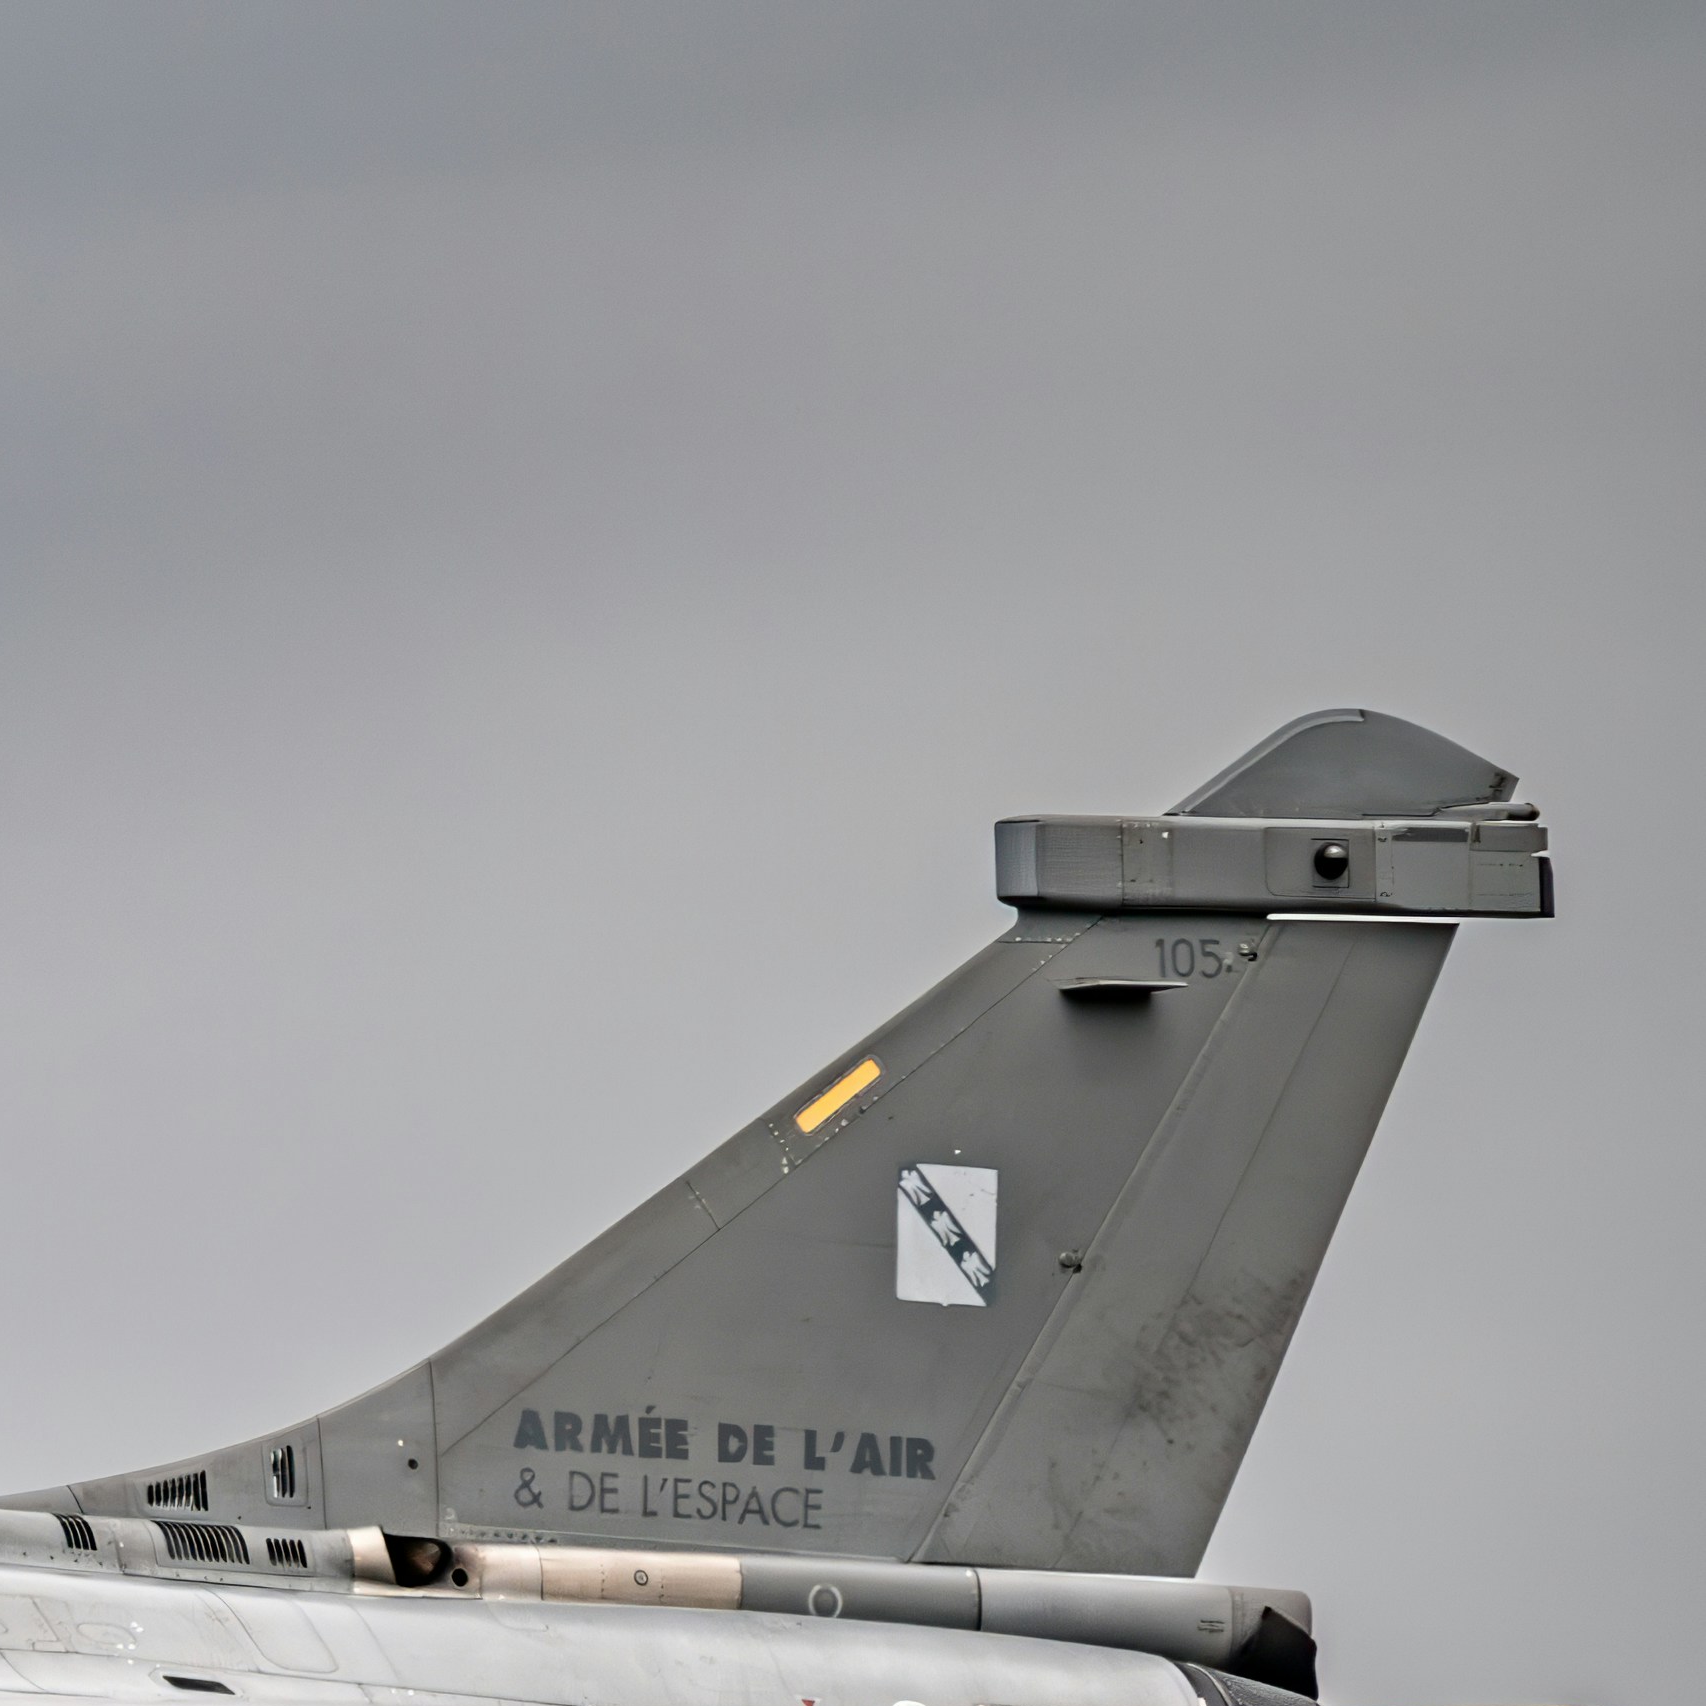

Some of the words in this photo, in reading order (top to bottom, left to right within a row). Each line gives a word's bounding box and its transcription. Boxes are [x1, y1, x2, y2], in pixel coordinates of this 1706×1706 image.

[1155, 938, 1223, 978] 105
[513, 1405, 689, 1460] ARMÉE
[717, 1422, 775, 1465] DE
[803, 1429, 936, 1480] L'AIR
[514, 1467, 543, 1509] &
[568, 1470, 619, 1514] DE
[641, 1474, 823, 1529] L'ESPACE
